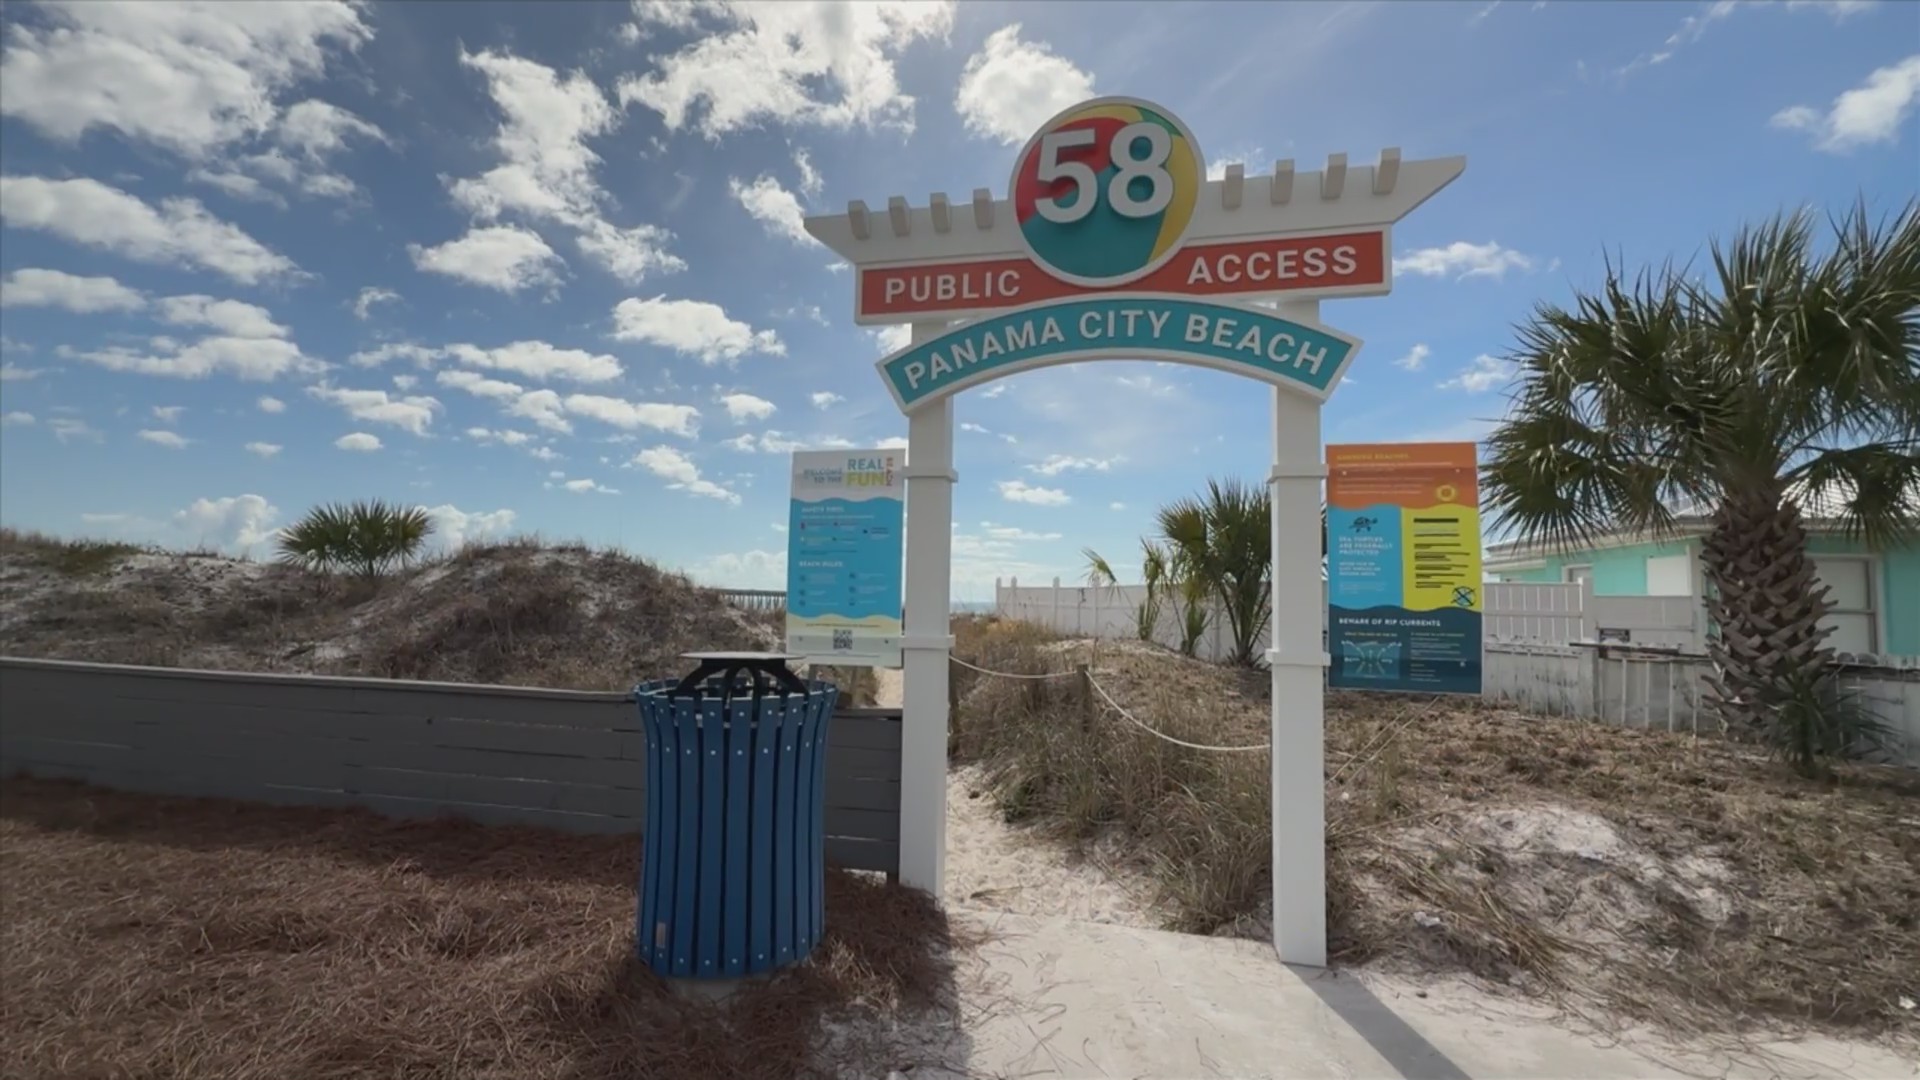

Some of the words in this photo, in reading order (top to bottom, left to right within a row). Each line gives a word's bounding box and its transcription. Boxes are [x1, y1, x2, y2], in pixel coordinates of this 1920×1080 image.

[1034, 122, 1174, 224] 58
[885, 270, 1020, 303] PUBLIC
[1187, 246, 1357, 284] ACCESS
[904, 317, 1065, 389] PANAMA
[1079, 310, 1171, 339] CITY
[1184, 313, 1327, 375] BEACH
[846, 472, 885, 486] FUN
[847, 459, 884, 470] REAL
[1338, 617, 1369, 625] BEWARE
[1399, 619, 1441, 627] CURRENTS
